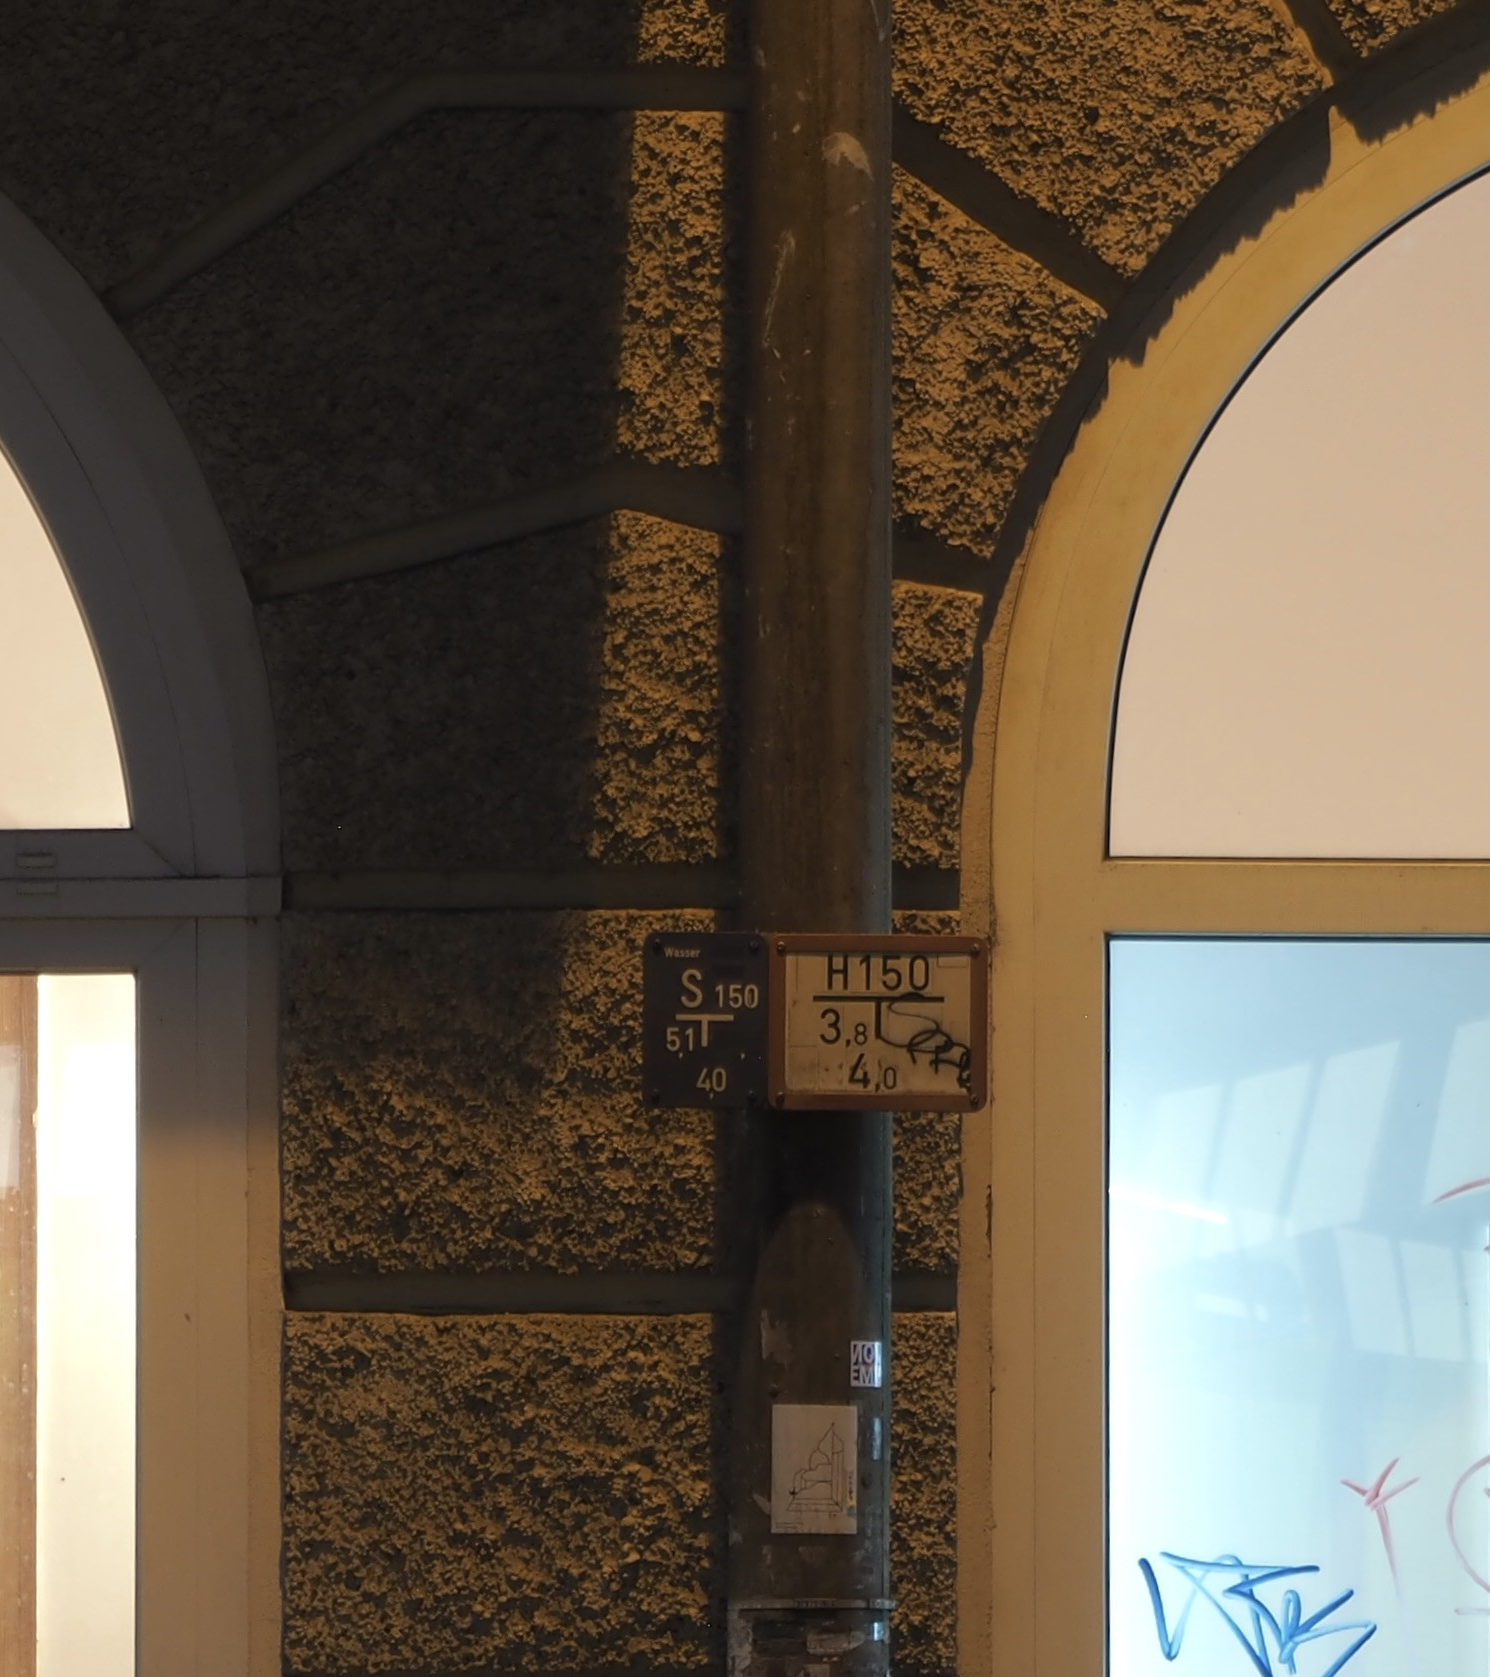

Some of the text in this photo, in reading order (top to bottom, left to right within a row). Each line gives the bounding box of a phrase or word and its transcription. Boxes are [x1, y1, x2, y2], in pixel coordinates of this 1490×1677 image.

[664, 946, 701, 958] Wasser
[681, 968, 759, 1009] S 150
[820, 1008, 868, 1048] 3,8
